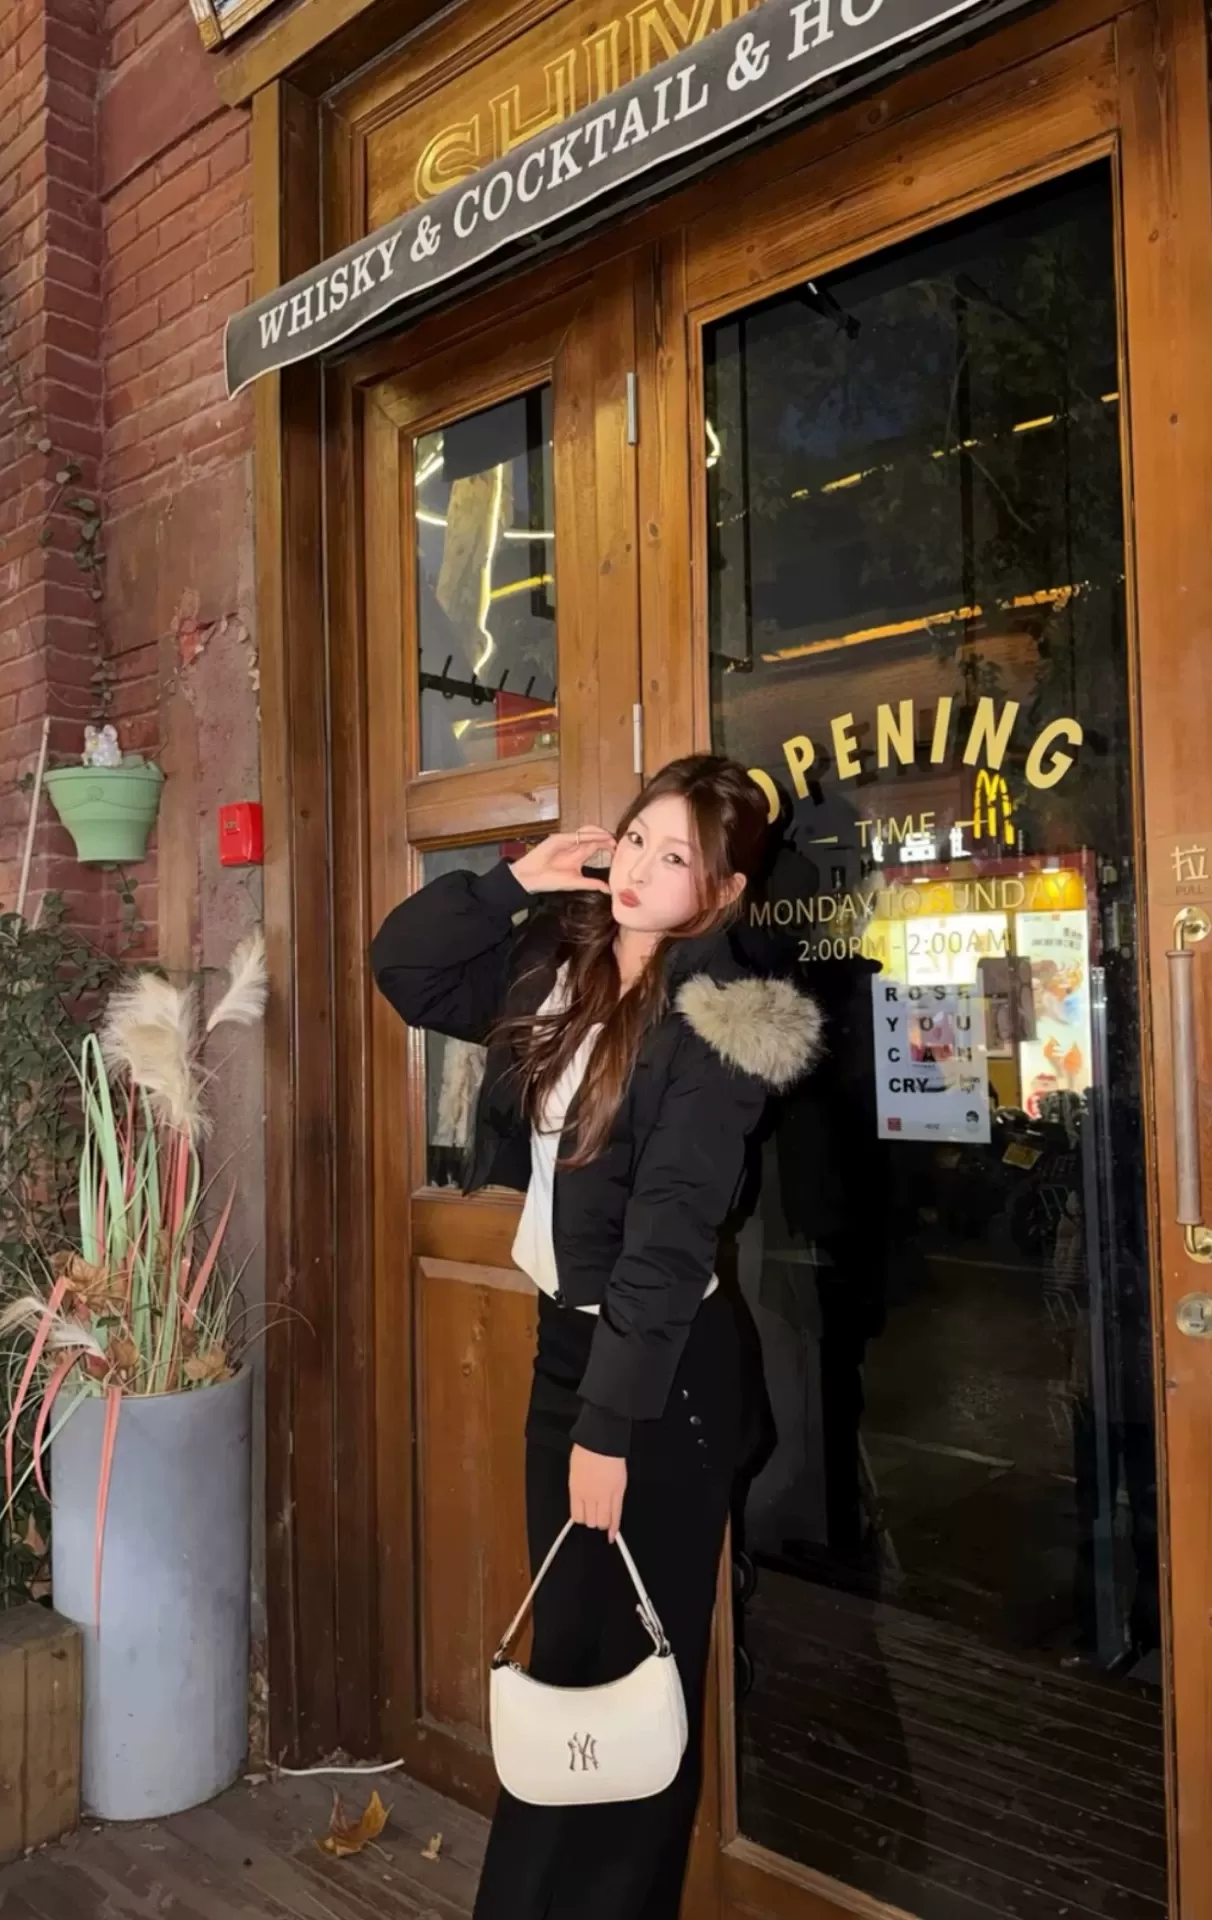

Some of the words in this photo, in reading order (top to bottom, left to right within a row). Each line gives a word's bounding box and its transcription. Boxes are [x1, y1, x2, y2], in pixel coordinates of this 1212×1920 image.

[258, 230, 401, 349] WHISKY
[411, 217, 441, 264] &
[453, 64, 709, 238] COCKTAIL
[726, 32, 770, 91] &
[854, 812, 937, 848] TIME
[1169, 844, 1209, 882] 拉
[750, 890, 874, 928] MONDAY
[880, 886, 923, 918] TO
[932, 876, 1071, 916] SUNDAY
[886, 1015, 971, 1032] YOU
[888, 1077, 929, 1094] CRY
